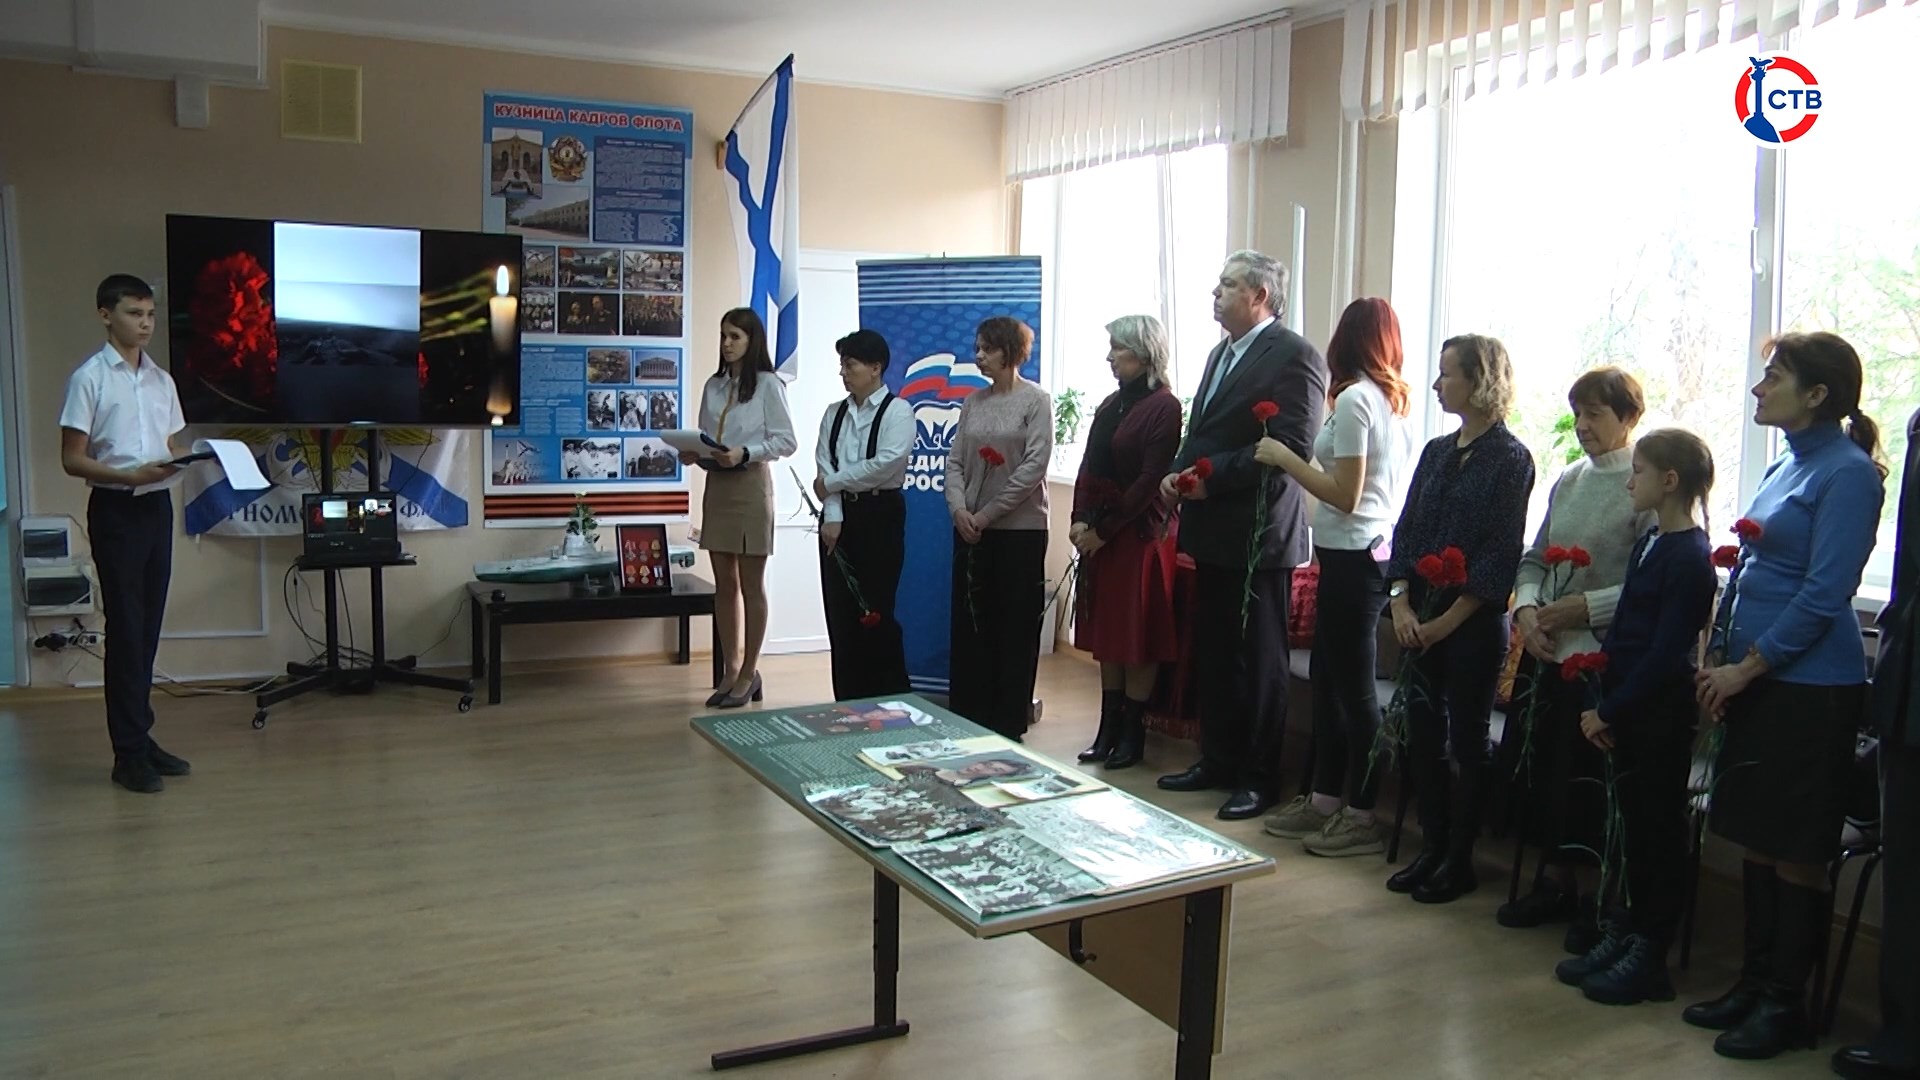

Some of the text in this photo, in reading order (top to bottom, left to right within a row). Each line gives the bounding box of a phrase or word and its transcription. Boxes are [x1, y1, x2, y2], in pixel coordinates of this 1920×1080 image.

[494, 103, 684, 132] КУЗНИЦА КАДРОВ ФЛОТА
[906, 454, 947, 472] ДИ
